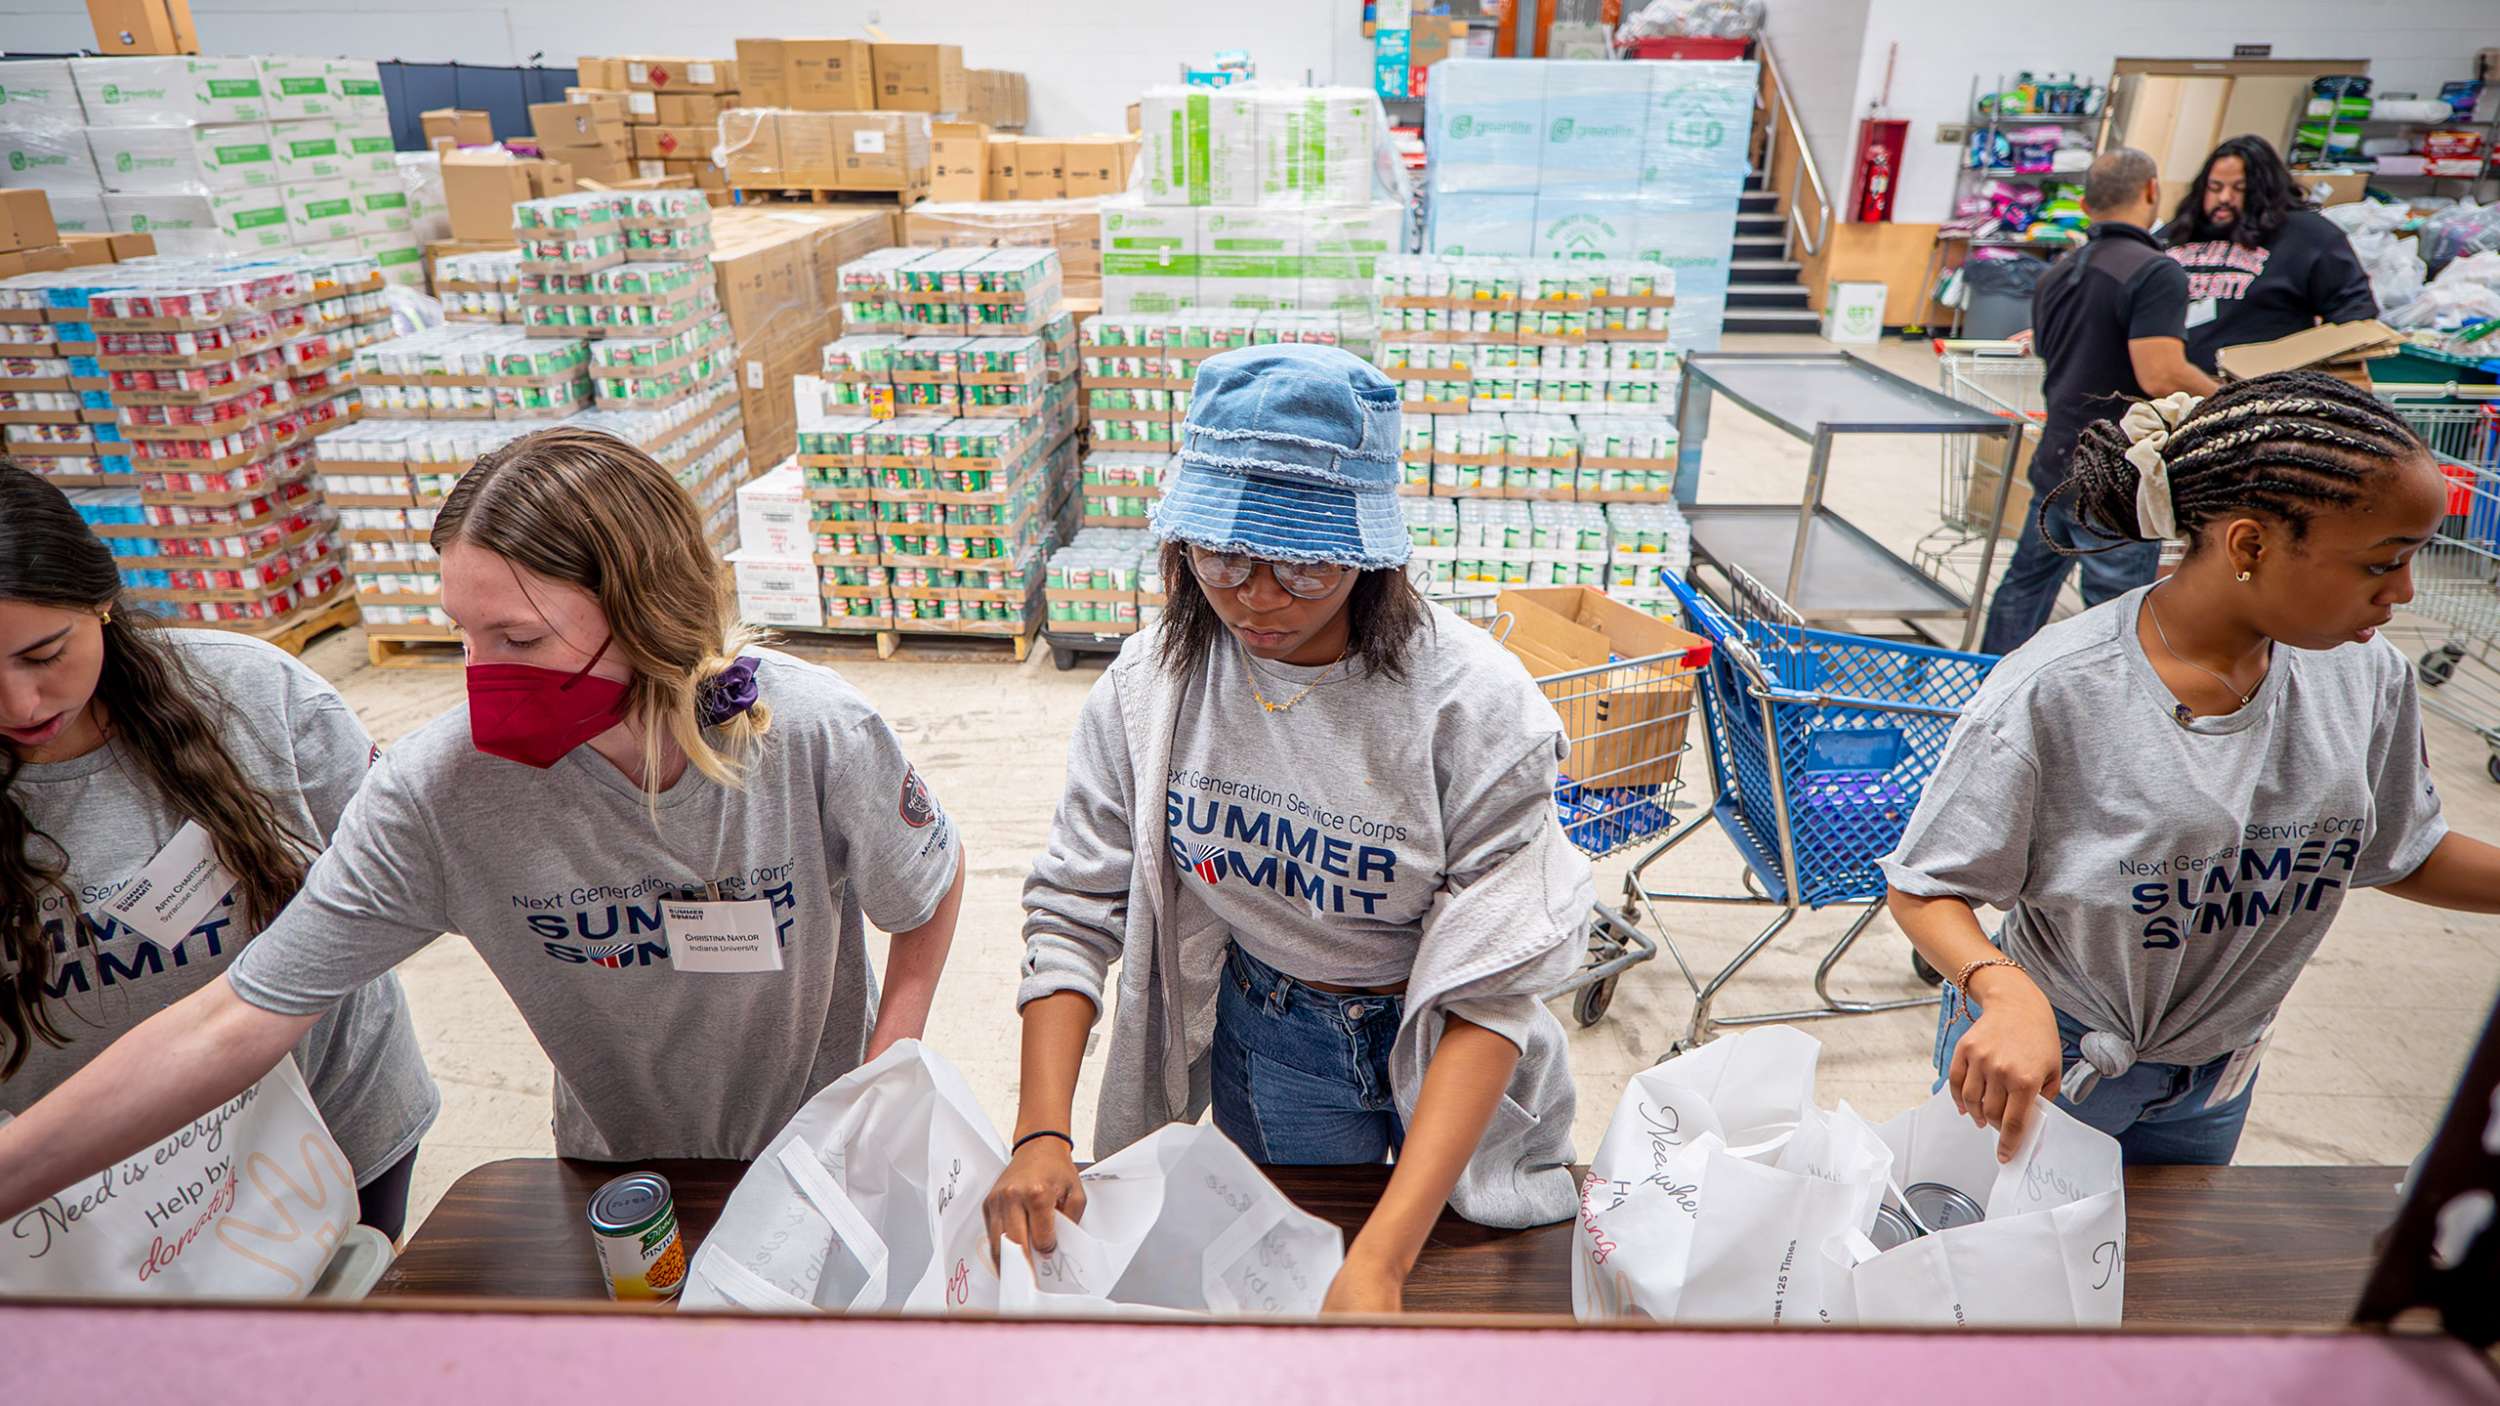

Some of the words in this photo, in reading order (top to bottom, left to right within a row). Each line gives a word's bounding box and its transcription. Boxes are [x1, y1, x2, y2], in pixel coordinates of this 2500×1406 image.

[1168, 768, 1187, 786] ext
[1190, 771, 1282, 808] Generation
[1349, 815, 1408, 843] Corps
[1168, 789, 1397, 883] SUMMER
[2119, 860, 2169, 876] Next
[2245, 821, 2319, 841] Service
[512, 893, 563, 910] Next
[570, 875, 677, 906] Generation
[750, 857, 795, 887] Corps
[160, 892, 192, 924] Syracuse
[689, 944, 719, 952] Indiana
[720, 944, 760, 953] University
[727, 933, 760, 942] NAYLOR
[13, 1166, 119, 1260] Need
[122, 1162, 149, 1186] is
[144, 1181, 205, 1230] Help
[205, 1155, 231, 1185] by
[641, 1236, 674, 1262] PINTO
[1780, 1239, 1797, 1273] Times
[1776, 1275, 1788, 1296] 125
